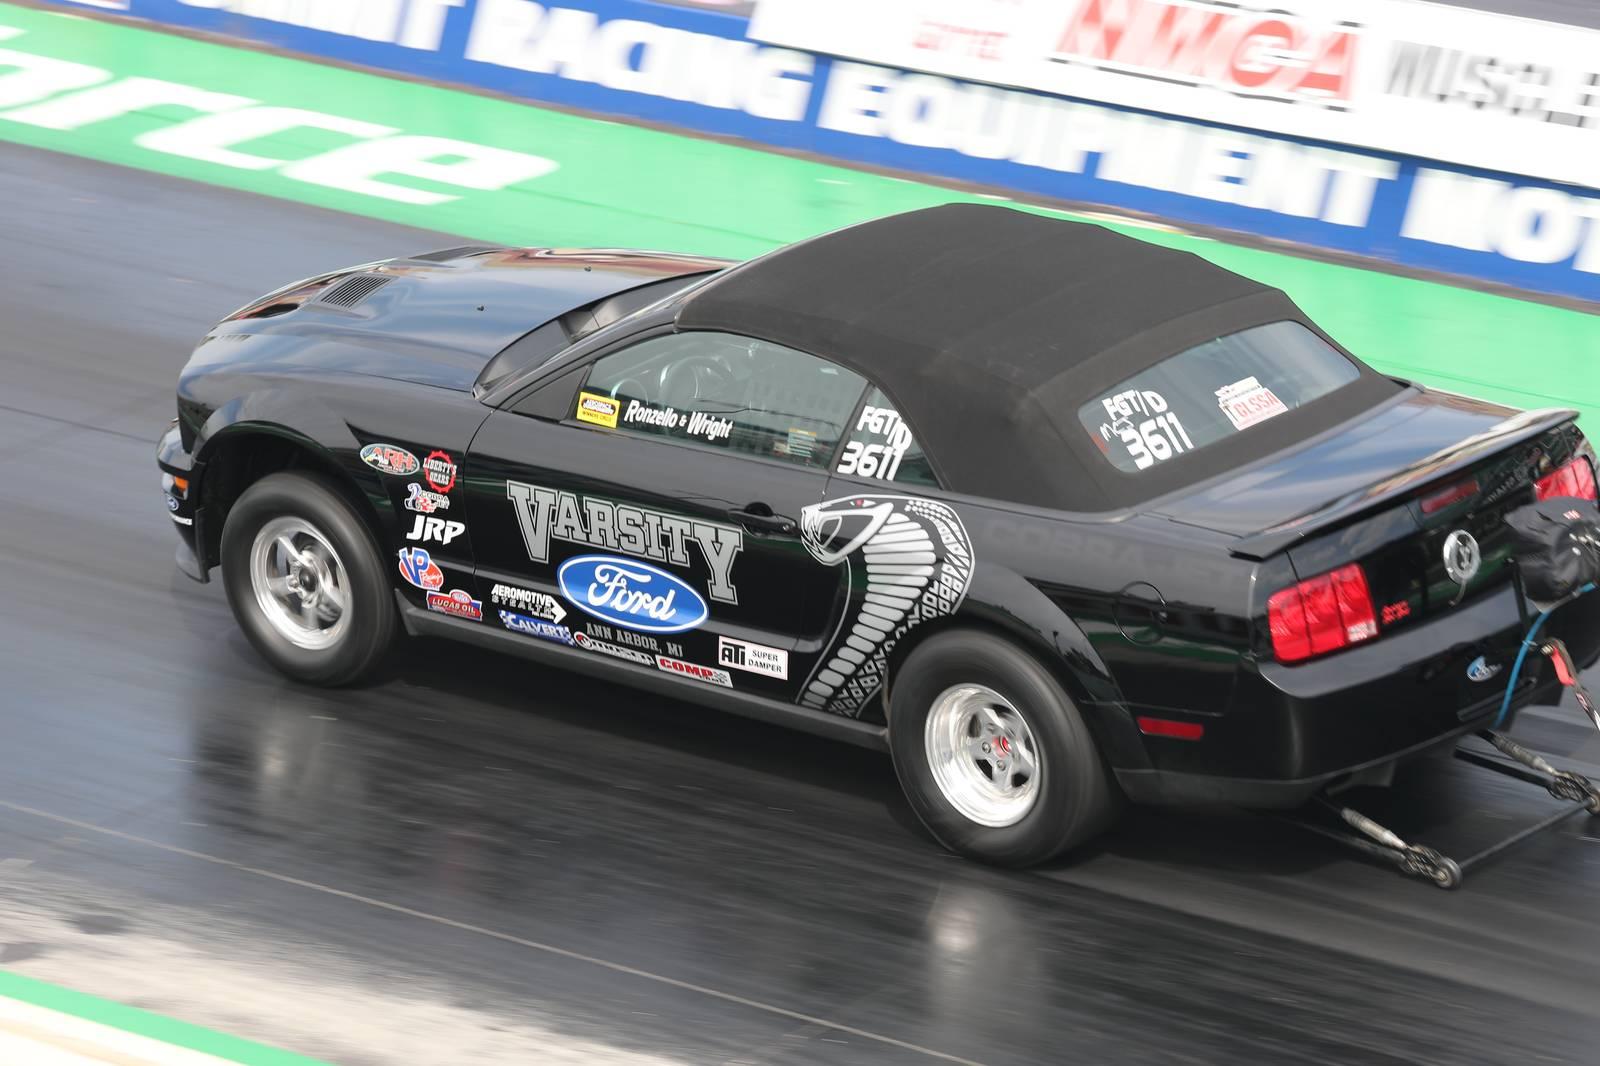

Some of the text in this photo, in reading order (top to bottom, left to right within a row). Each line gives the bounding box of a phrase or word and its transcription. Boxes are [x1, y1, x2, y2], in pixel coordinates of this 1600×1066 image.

[463, 0, 815, 122] RACING
[815, 56, 1400, 228] EQUIPMENT
[623, 399, 733, 441] Ronzello & Wright
[1120, 411, 1194, 470] 3611
[422, 457, 458, 476] LIBERTY'S
[837, 440, 905, 481] 3611
[406, 514, 466, 546] JRP
[506, 479, 744, 606] VARSITY
[398, 547, 431, 587] VP
[431, 597, 460, 610] LUCAS
[461, 604, 476, 615] OIL
[491, 583, 553, 607] AEROMOTIVE
[587, 564, 677, 620] Ford
[586, 622, 612, 640] ANN
[616, 630, 663, 654] ARBOR,
[666, 641, 684, 657] MI
[752, 649, 779, 662] SUPER
[659, 657, 713, 679] COMP
[748, 659, 782, 673] DAMPER
